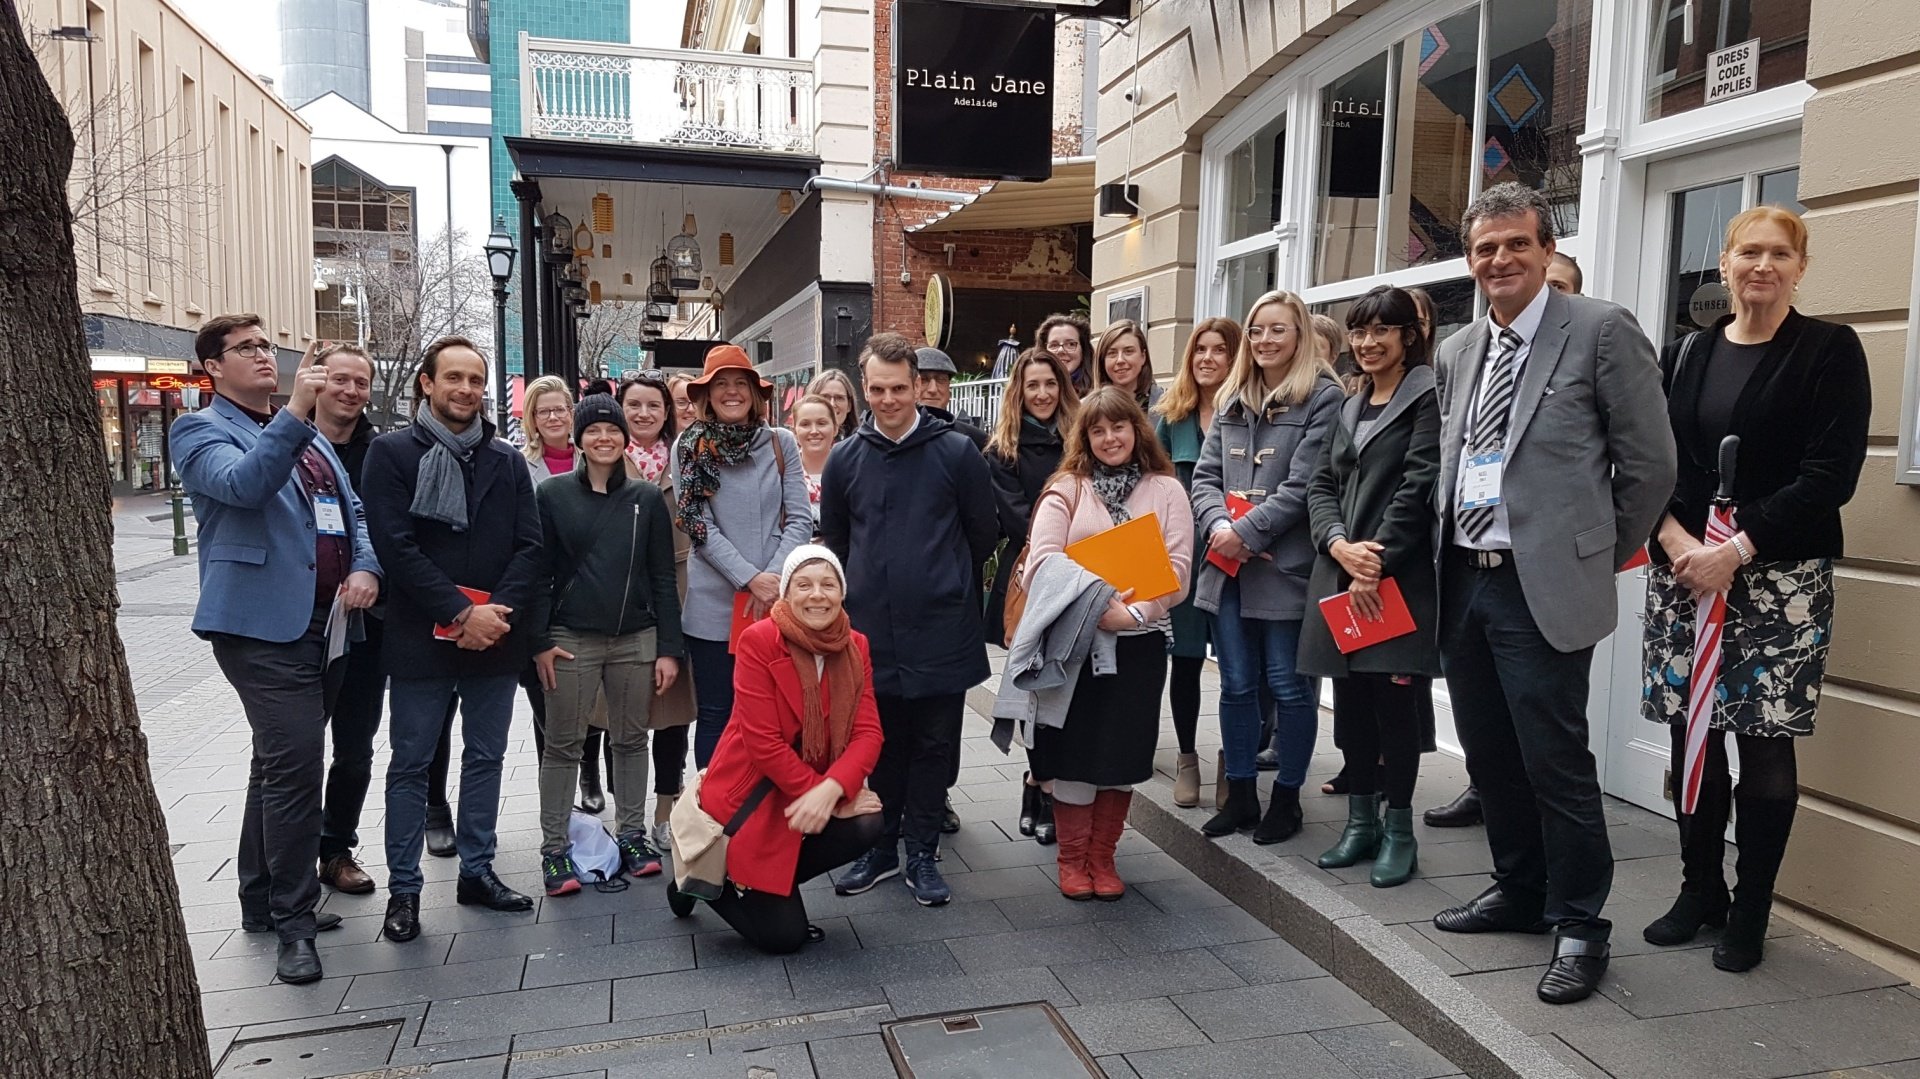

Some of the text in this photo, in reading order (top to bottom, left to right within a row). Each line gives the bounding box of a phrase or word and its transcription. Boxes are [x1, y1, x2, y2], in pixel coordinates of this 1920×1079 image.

[1717, 47, 1750, 67] DRESS
[906, 68, 1046, 95] Plain Jane
[1718, 63, 1746, 81] CODE
[1710, 76, 1752, 98] APPLIES
[954, 97, 998, 108] Adelaide
[1693, 299, 1728, 312] CLOSED
